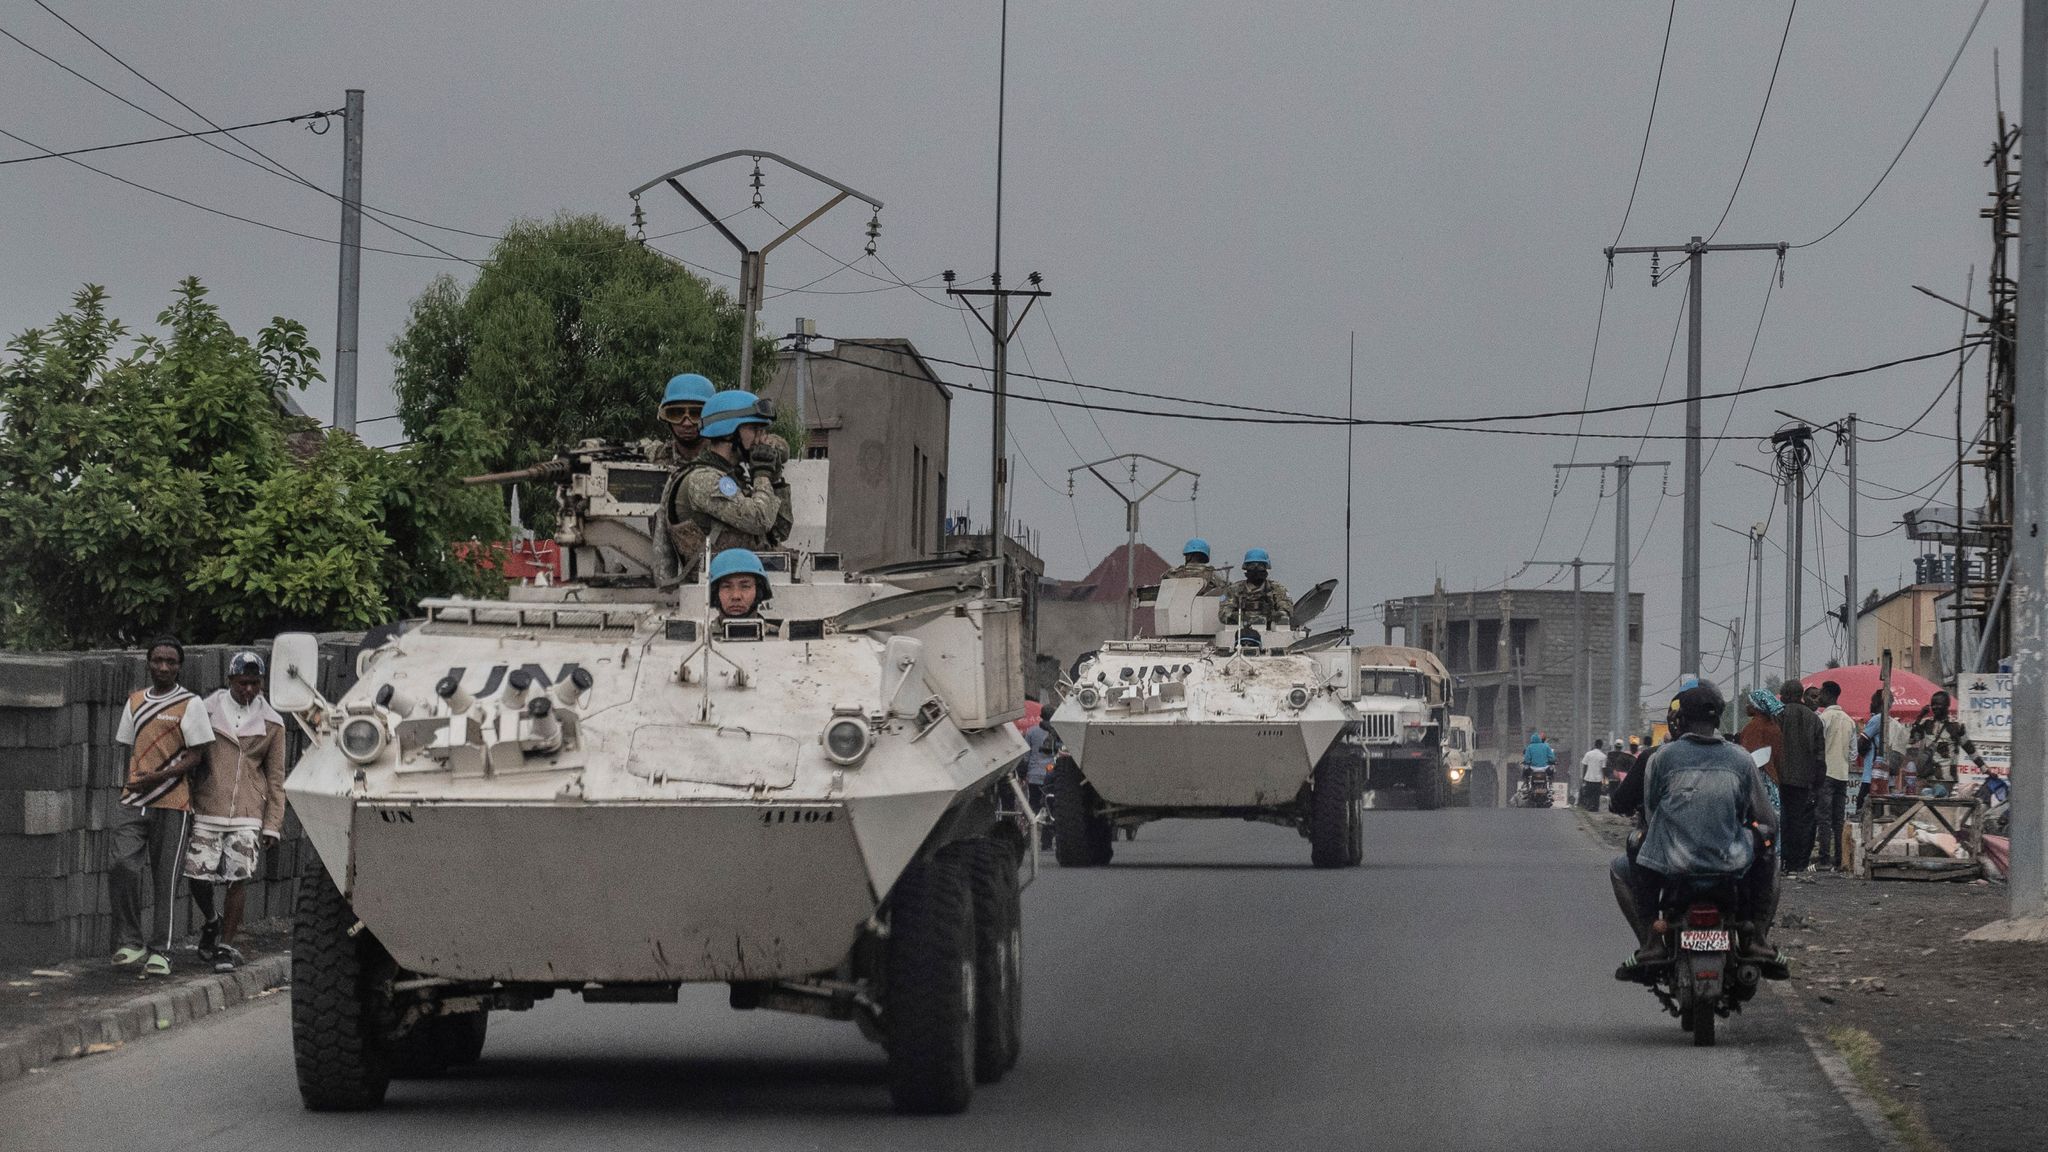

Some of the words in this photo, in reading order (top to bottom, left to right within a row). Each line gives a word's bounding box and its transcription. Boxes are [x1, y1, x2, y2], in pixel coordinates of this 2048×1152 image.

[447, 663, 579, 699] UN
[380, 810, 414, 823] UN
[759, 810, 833, 823] 41104
